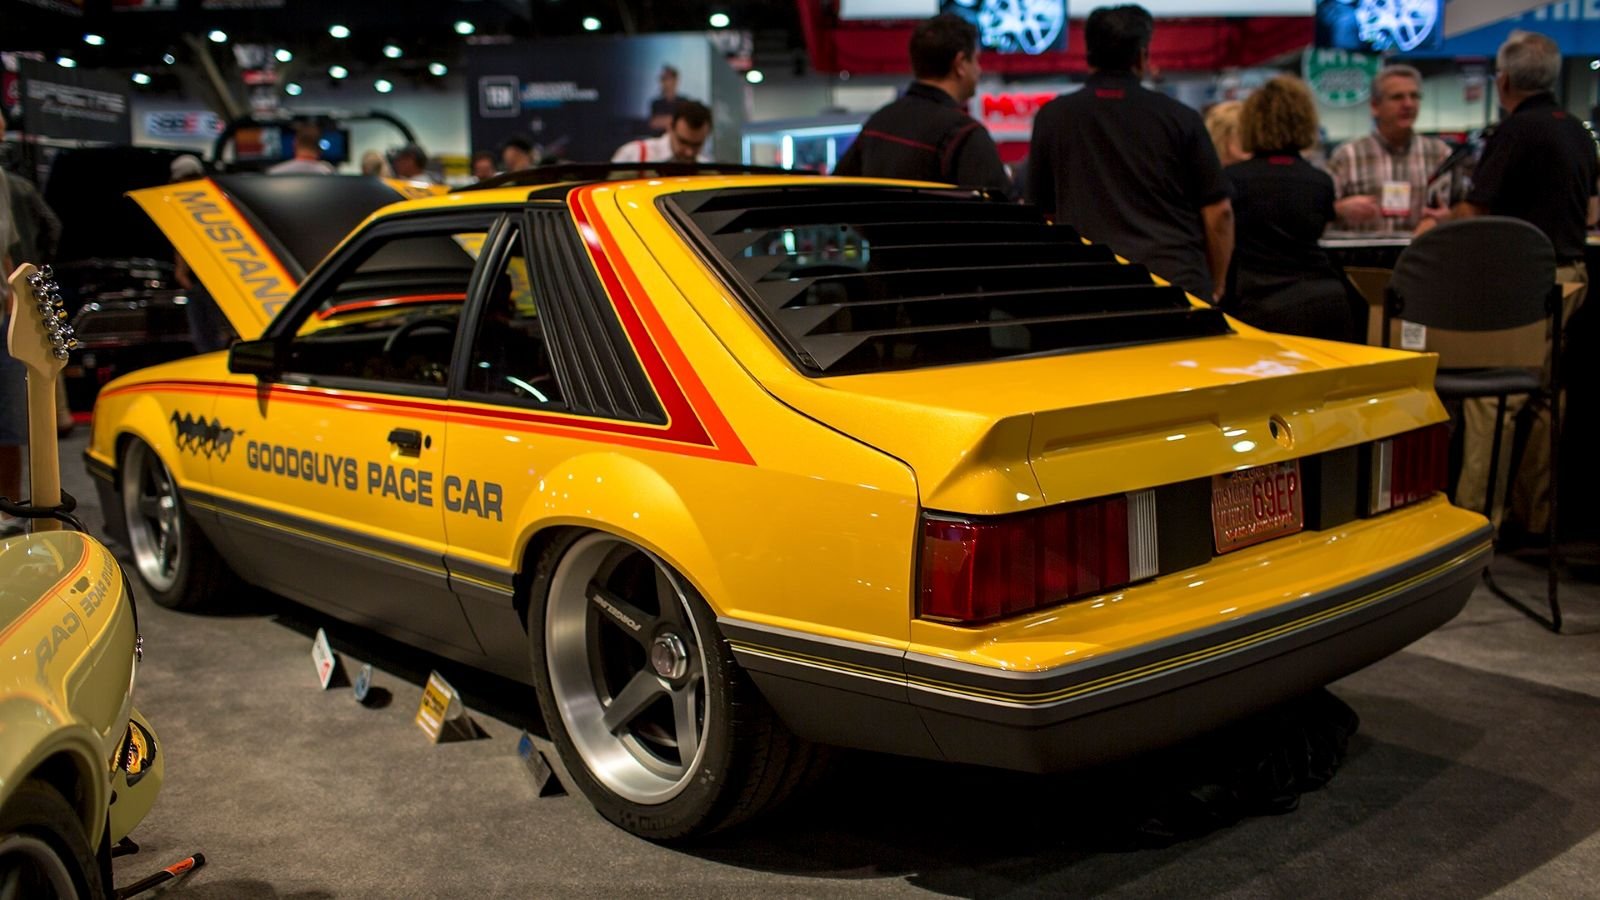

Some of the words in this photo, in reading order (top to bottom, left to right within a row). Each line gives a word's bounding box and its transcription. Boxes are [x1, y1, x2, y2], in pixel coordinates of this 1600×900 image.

[247, 440, 358, 491] GOODGUYS
[367, 461, 433, 507] PACE
[444, 475, 503, 522] CAR
[1252, 471, 1298, 519] 69EP
